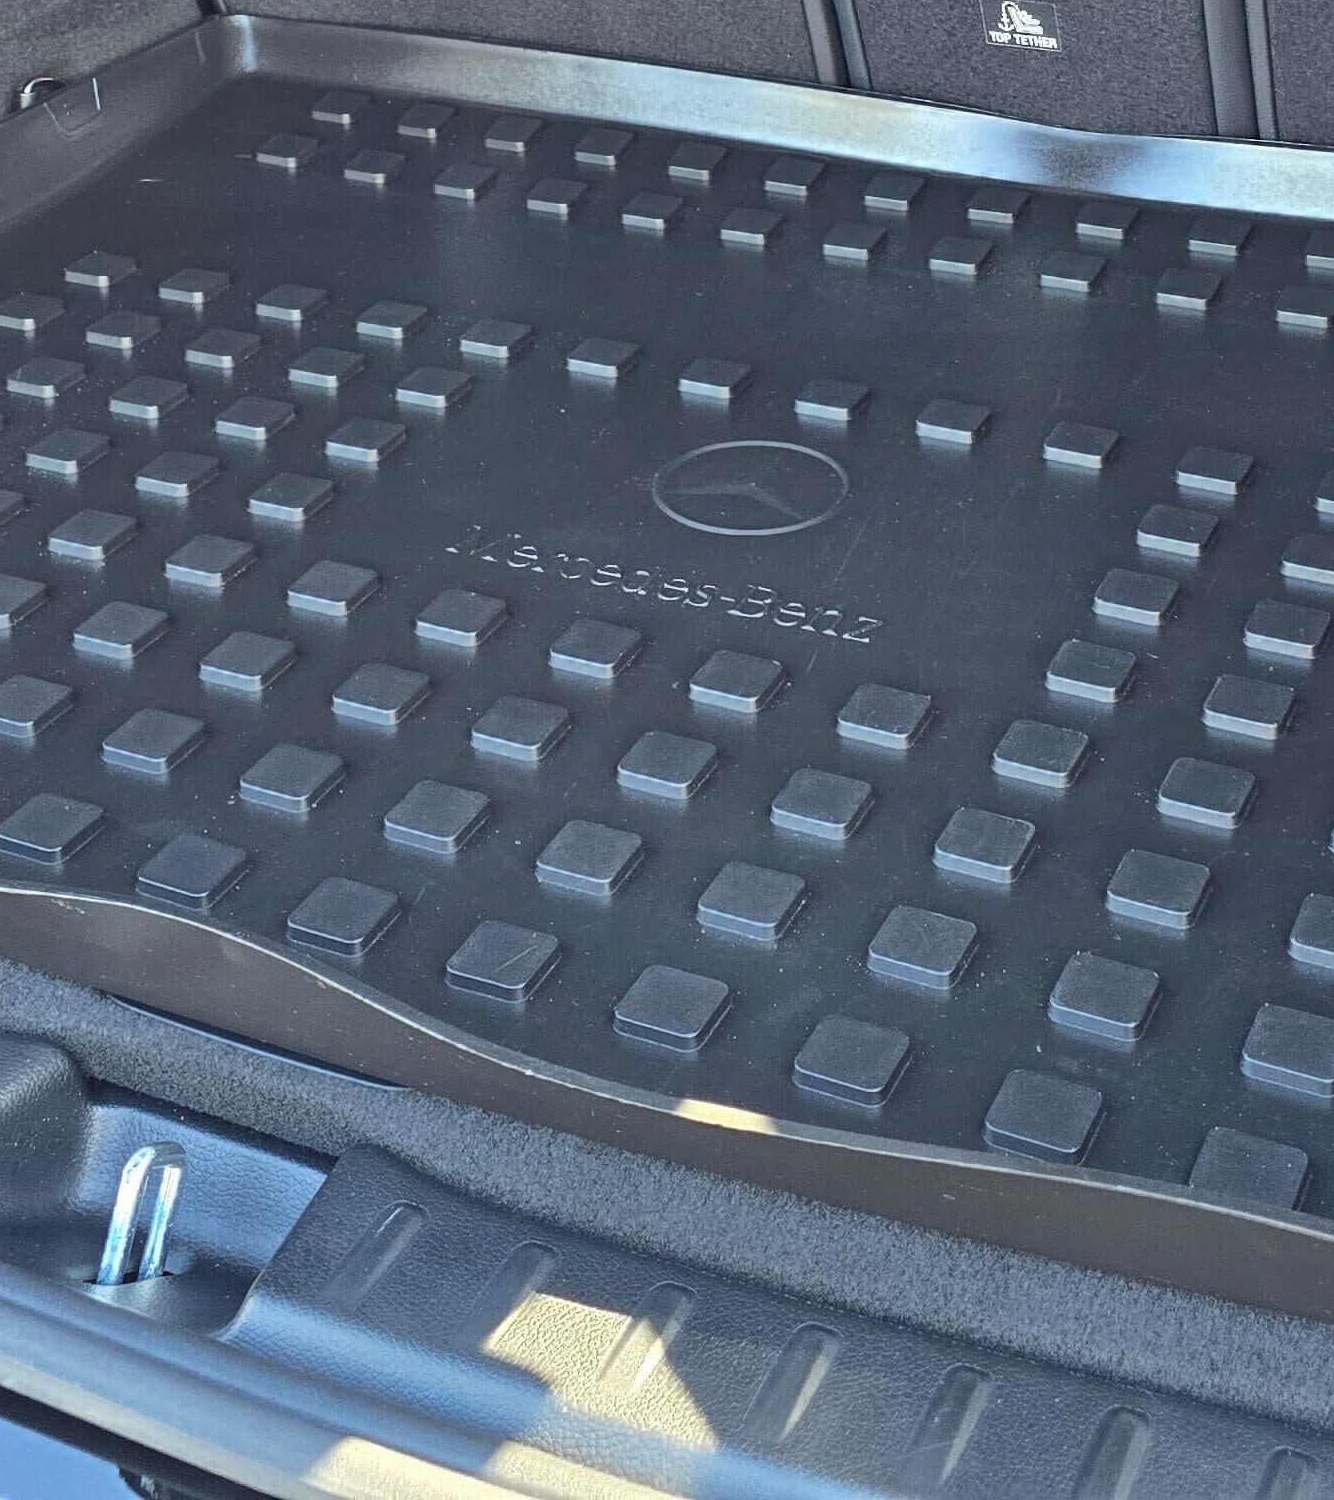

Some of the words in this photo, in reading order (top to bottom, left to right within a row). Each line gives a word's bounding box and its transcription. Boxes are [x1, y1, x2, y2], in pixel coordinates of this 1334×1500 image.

[988, 30, 1011, 43] TOP
[1012, 33, 1058, 49] TETHER
[444, 524, 885, 643] Mercedes-Benz
